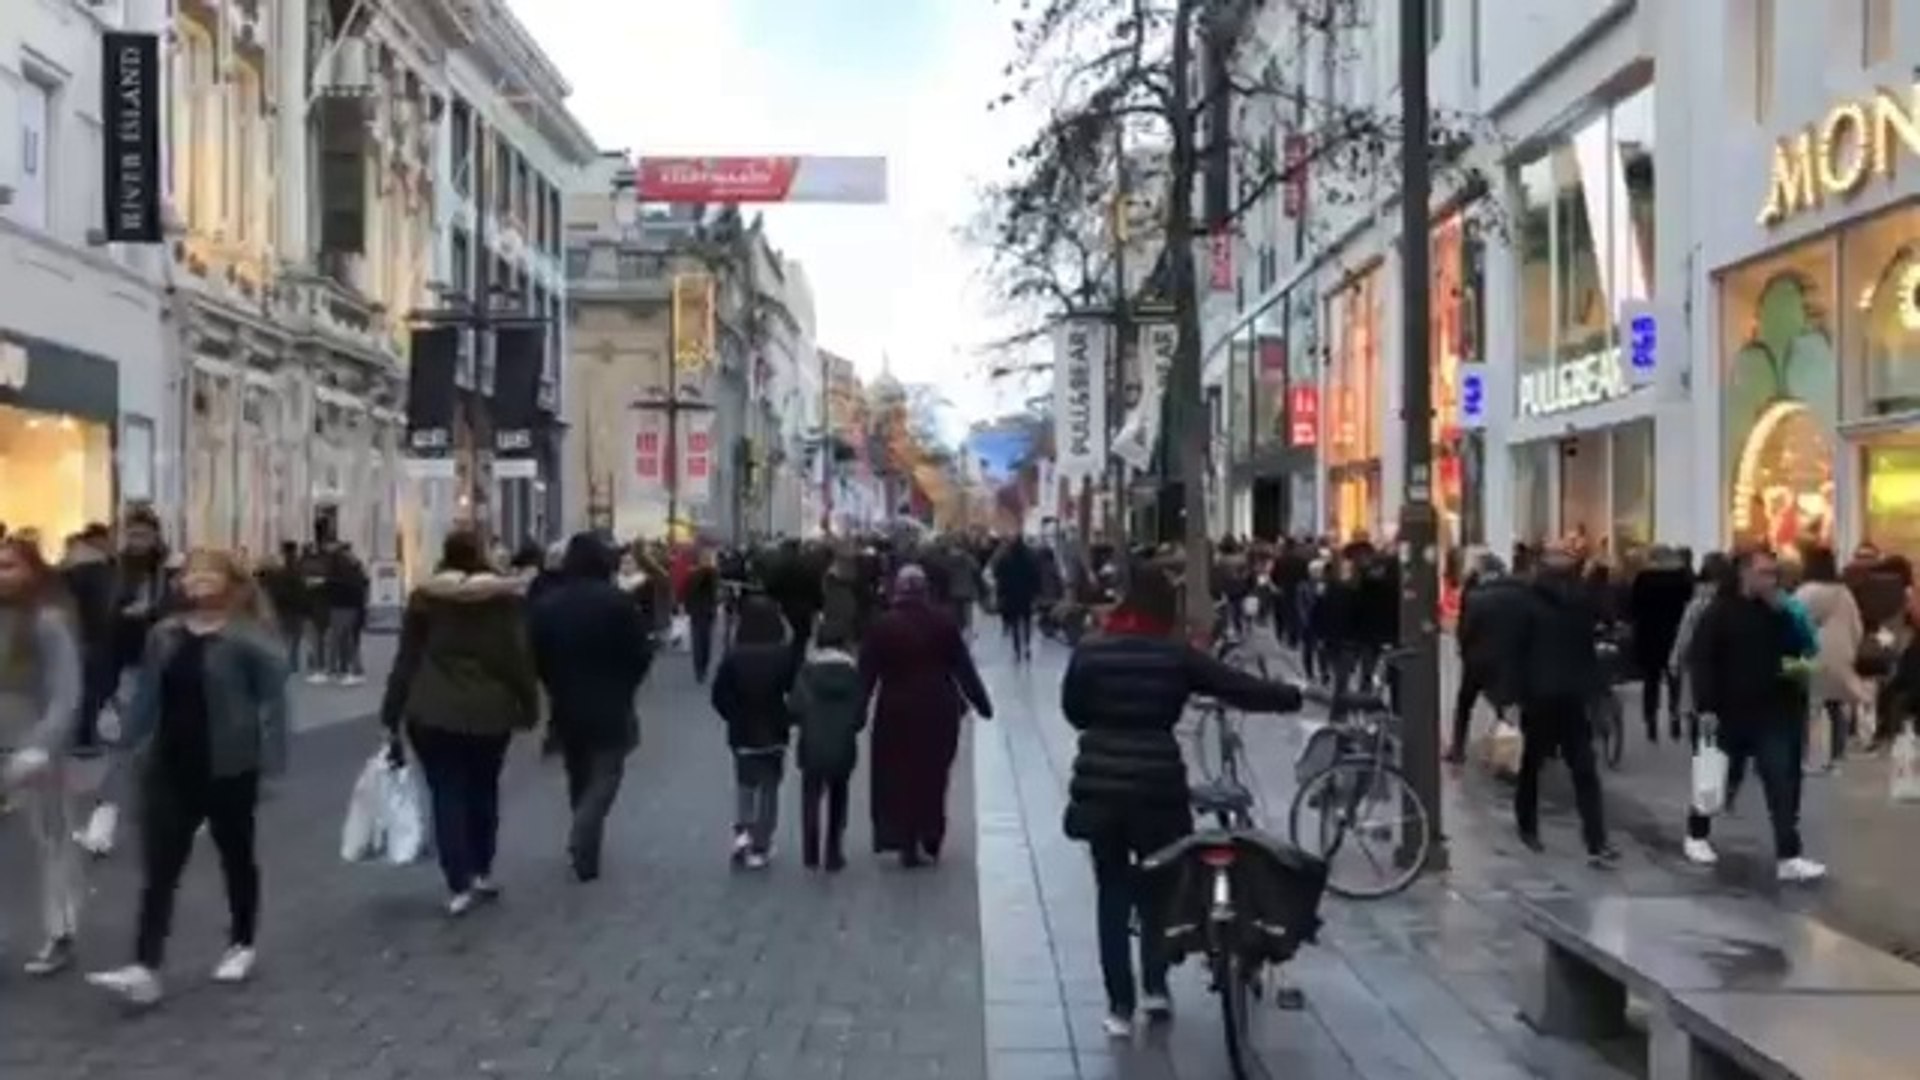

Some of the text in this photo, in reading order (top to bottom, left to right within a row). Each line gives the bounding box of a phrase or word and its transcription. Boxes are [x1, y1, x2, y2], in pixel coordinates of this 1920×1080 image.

[119, 47, 142, 230] RIVER ISLAND
[1067, 330, 1090, 456] PULL&BEAR
